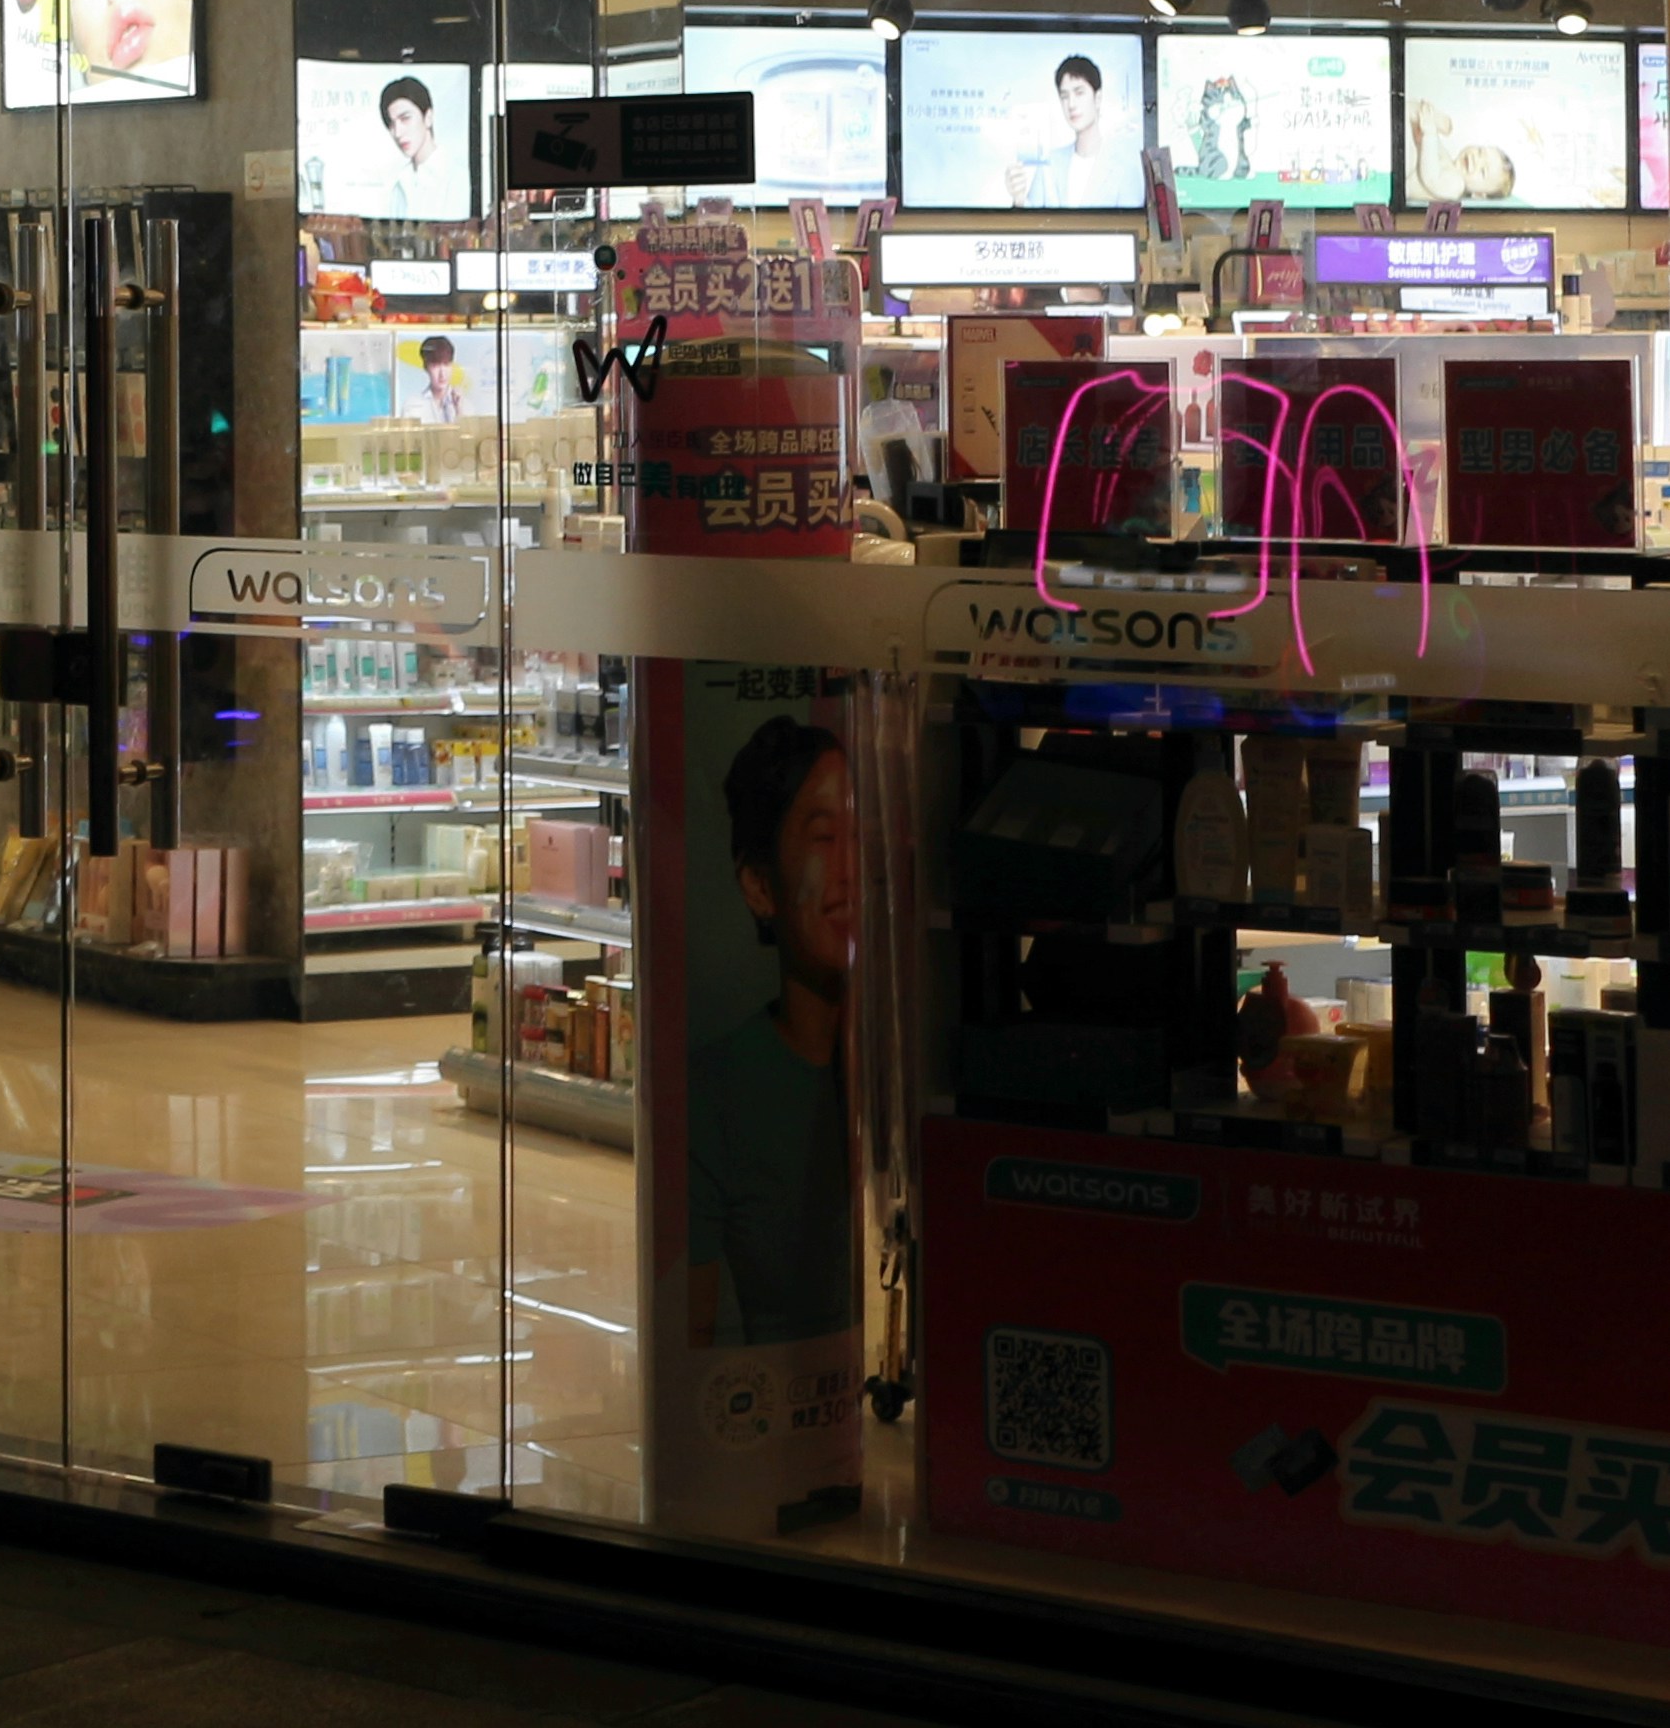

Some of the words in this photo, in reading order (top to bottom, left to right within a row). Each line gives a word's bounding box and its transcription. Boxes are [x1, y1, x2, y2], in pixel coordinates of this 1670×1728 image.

[1387, 239, 1476, 266] 敏感肌护理
[1387, 266, 1431, 280] Sensitive
[1433, 266, 1477, 280] Skincare
[963, 327, 996, 342] MARVEL
[1459, 428, 1622, 475] 型男必备
[227, 568, 445, 609] watsons
[969, 603, 1238, 651] watsons
[704, 665, 818, 701] 一起变美
[1012, 1169, 1169, 1209] watsons
[1248, 1183, 1421, 1230] 美好新试界
[1327, 1225, 1424, 1250] BEAUTIFUL
[1218, 1298, 1468, 1374] 全场跨品牌
